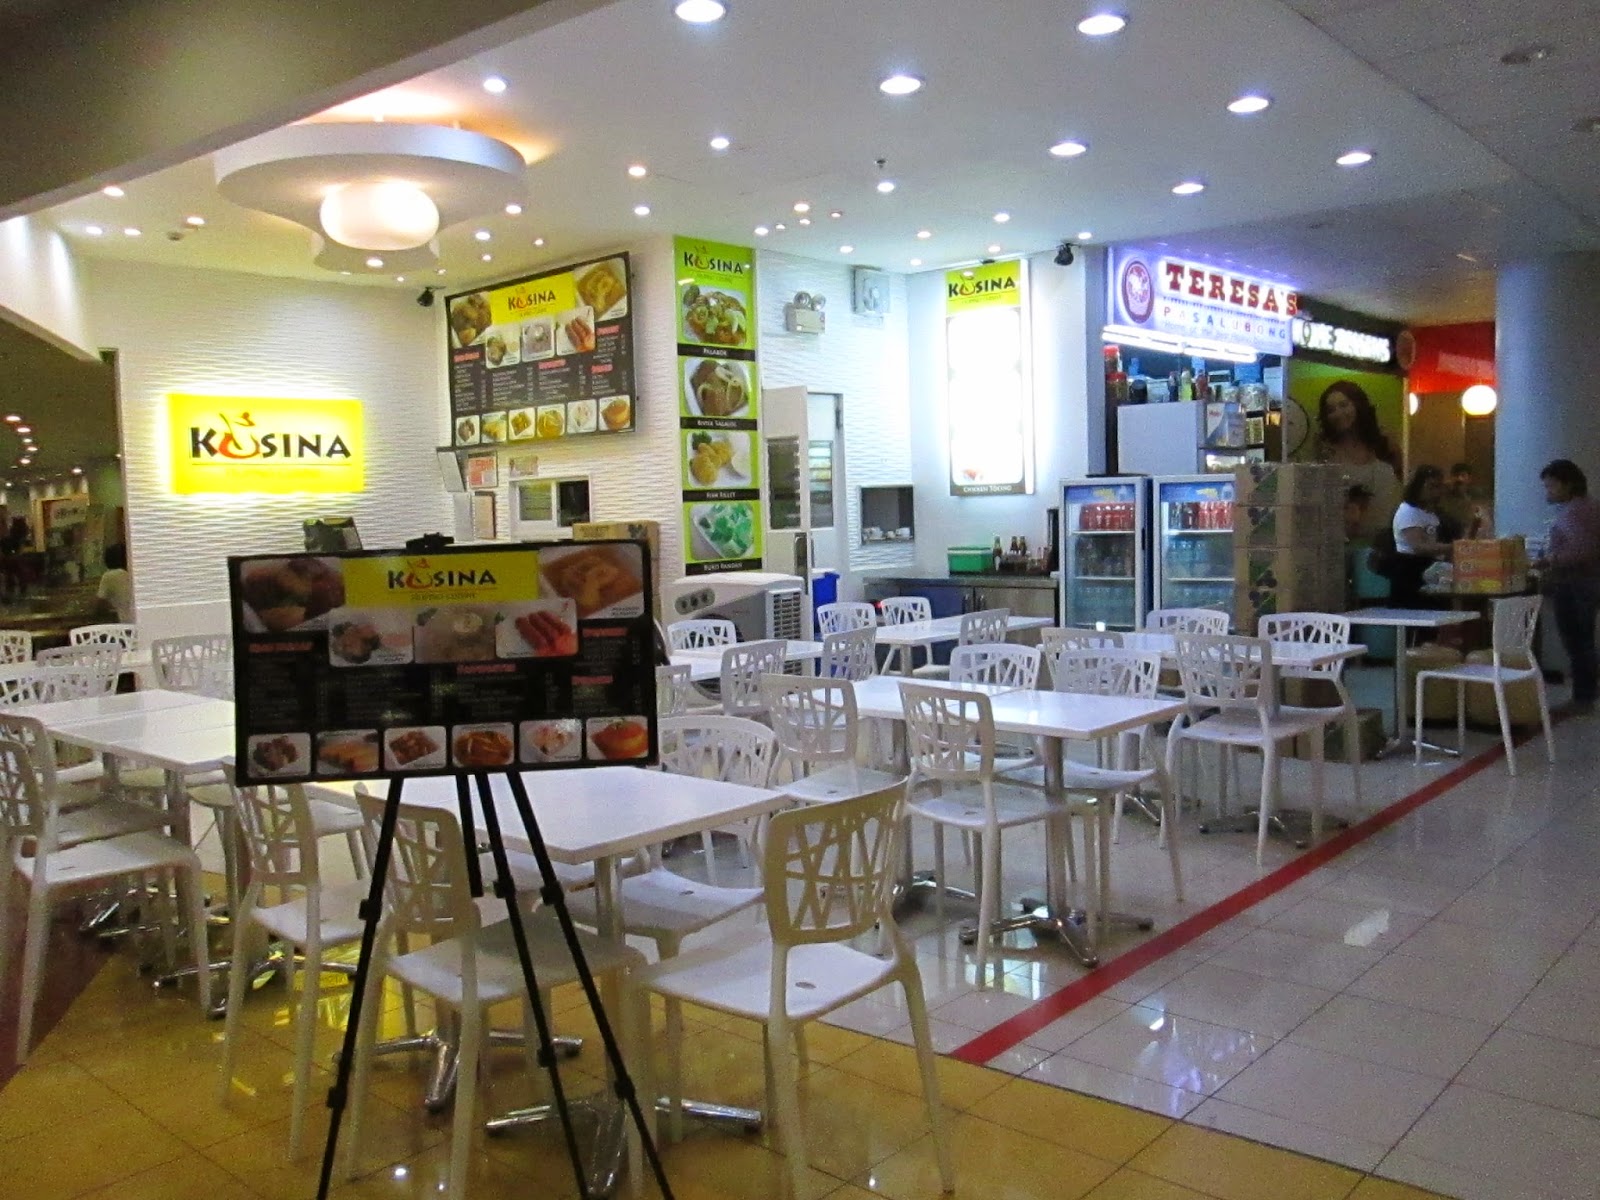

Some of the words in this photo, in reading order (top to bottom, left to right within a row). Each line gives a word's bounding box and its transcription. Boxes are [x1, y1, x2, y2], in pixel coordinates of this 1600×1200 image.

[1165, 261, 1298, 317] TERESA'S
[1163, 305, 1287, 340] PASALUBONG
[190, 420, 352, 460] KUSINA
[388, 566, 497, 590] KUSINA
